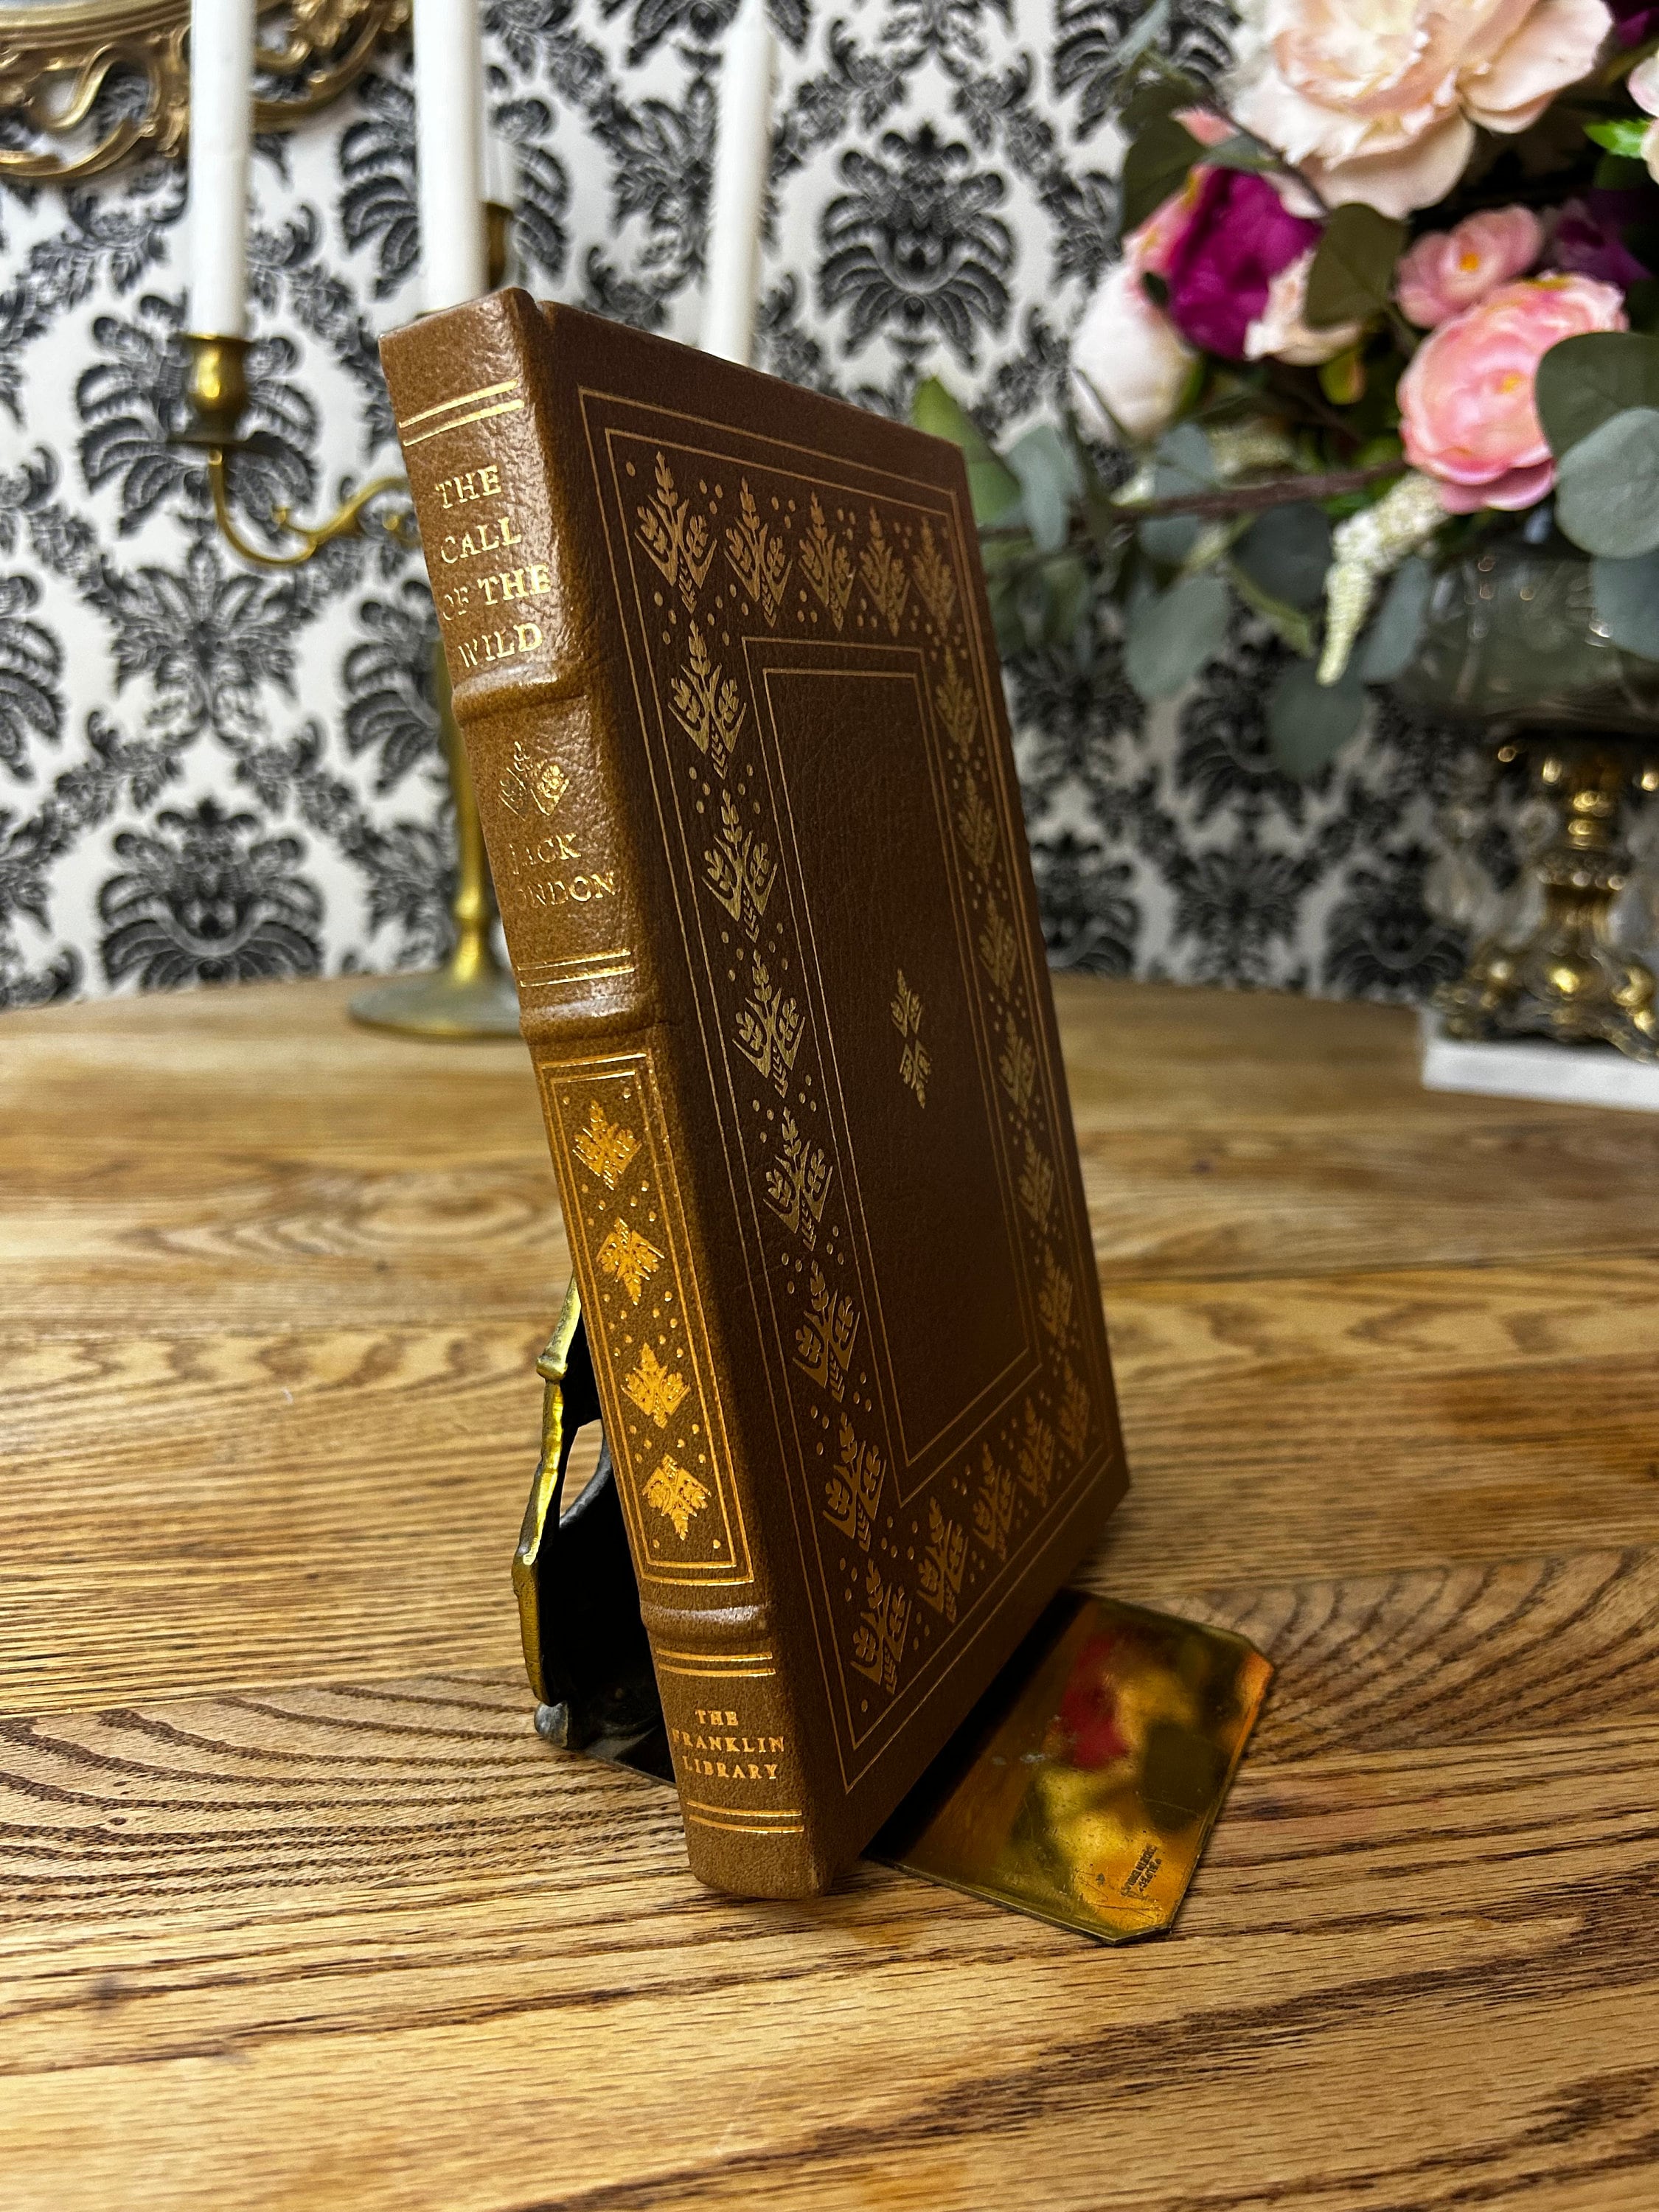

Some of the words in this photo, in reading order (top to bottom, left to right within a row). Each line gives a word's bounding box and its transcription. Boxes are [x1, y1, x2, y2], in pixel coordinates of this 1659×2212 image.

[435, 465, 501, 509] THE
[441, 516, 522, 563] CALL
[442, 586, 470, 621] OF
[477, 563, 552, 606] THE
[457, 622, 543, 668] WILD
[513, 872, 616, 911] ONDON
[695, 1708, 739, 1726] THE
[672, 1728, 785, 1753] FRANKLIN
[682, 1755, 779, 1780] LIBRARY
